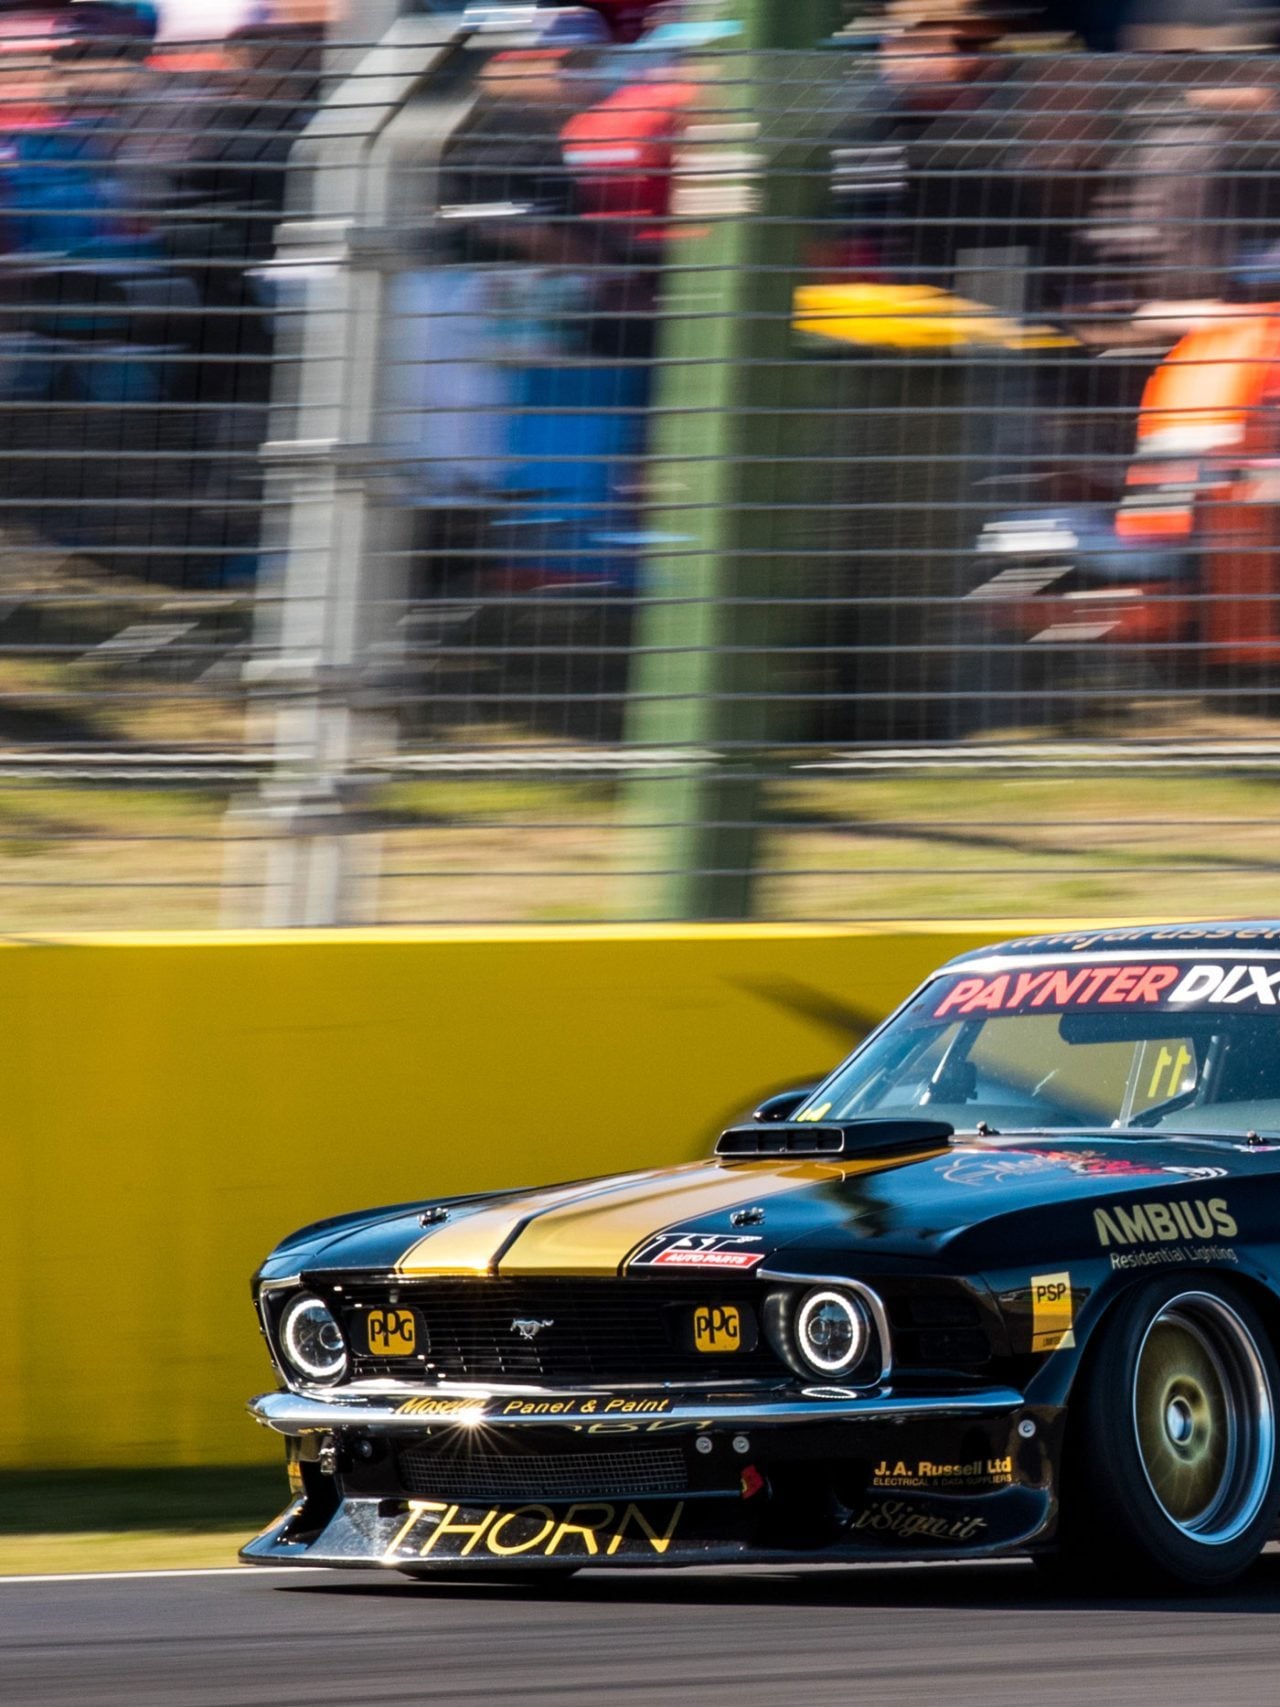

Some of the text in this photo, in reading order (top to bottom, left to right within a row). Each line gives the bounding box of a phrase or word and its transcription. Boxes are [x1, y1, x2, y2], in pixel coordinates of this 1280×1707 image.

[934, 965, 1180, 1018] PAYNTER
[1093, 1198, 1238, 1246] AMBIUS
[664, 1253, 748, 1264] AUTO PARTS
[1110, 1245, 1239, 1270] Residential Lighting
[1037, 1283, 1066, 1304] PSP
[370, 1309, 415, 1347] PPG
[695, 1308, 741, 1345] PPG
[503, 1400, 575, 1415] Panel
[580, 1400, 597, 1413] &
[604, 1399, 670, 1413] Paint
[918, 1460, 982, 1476] Russell
[987, 1456, 1012, 1475] Ltd
[873, 1477, 929, 1486] ELECTRICAL
[382, 1500, 685, 1561] THORN
